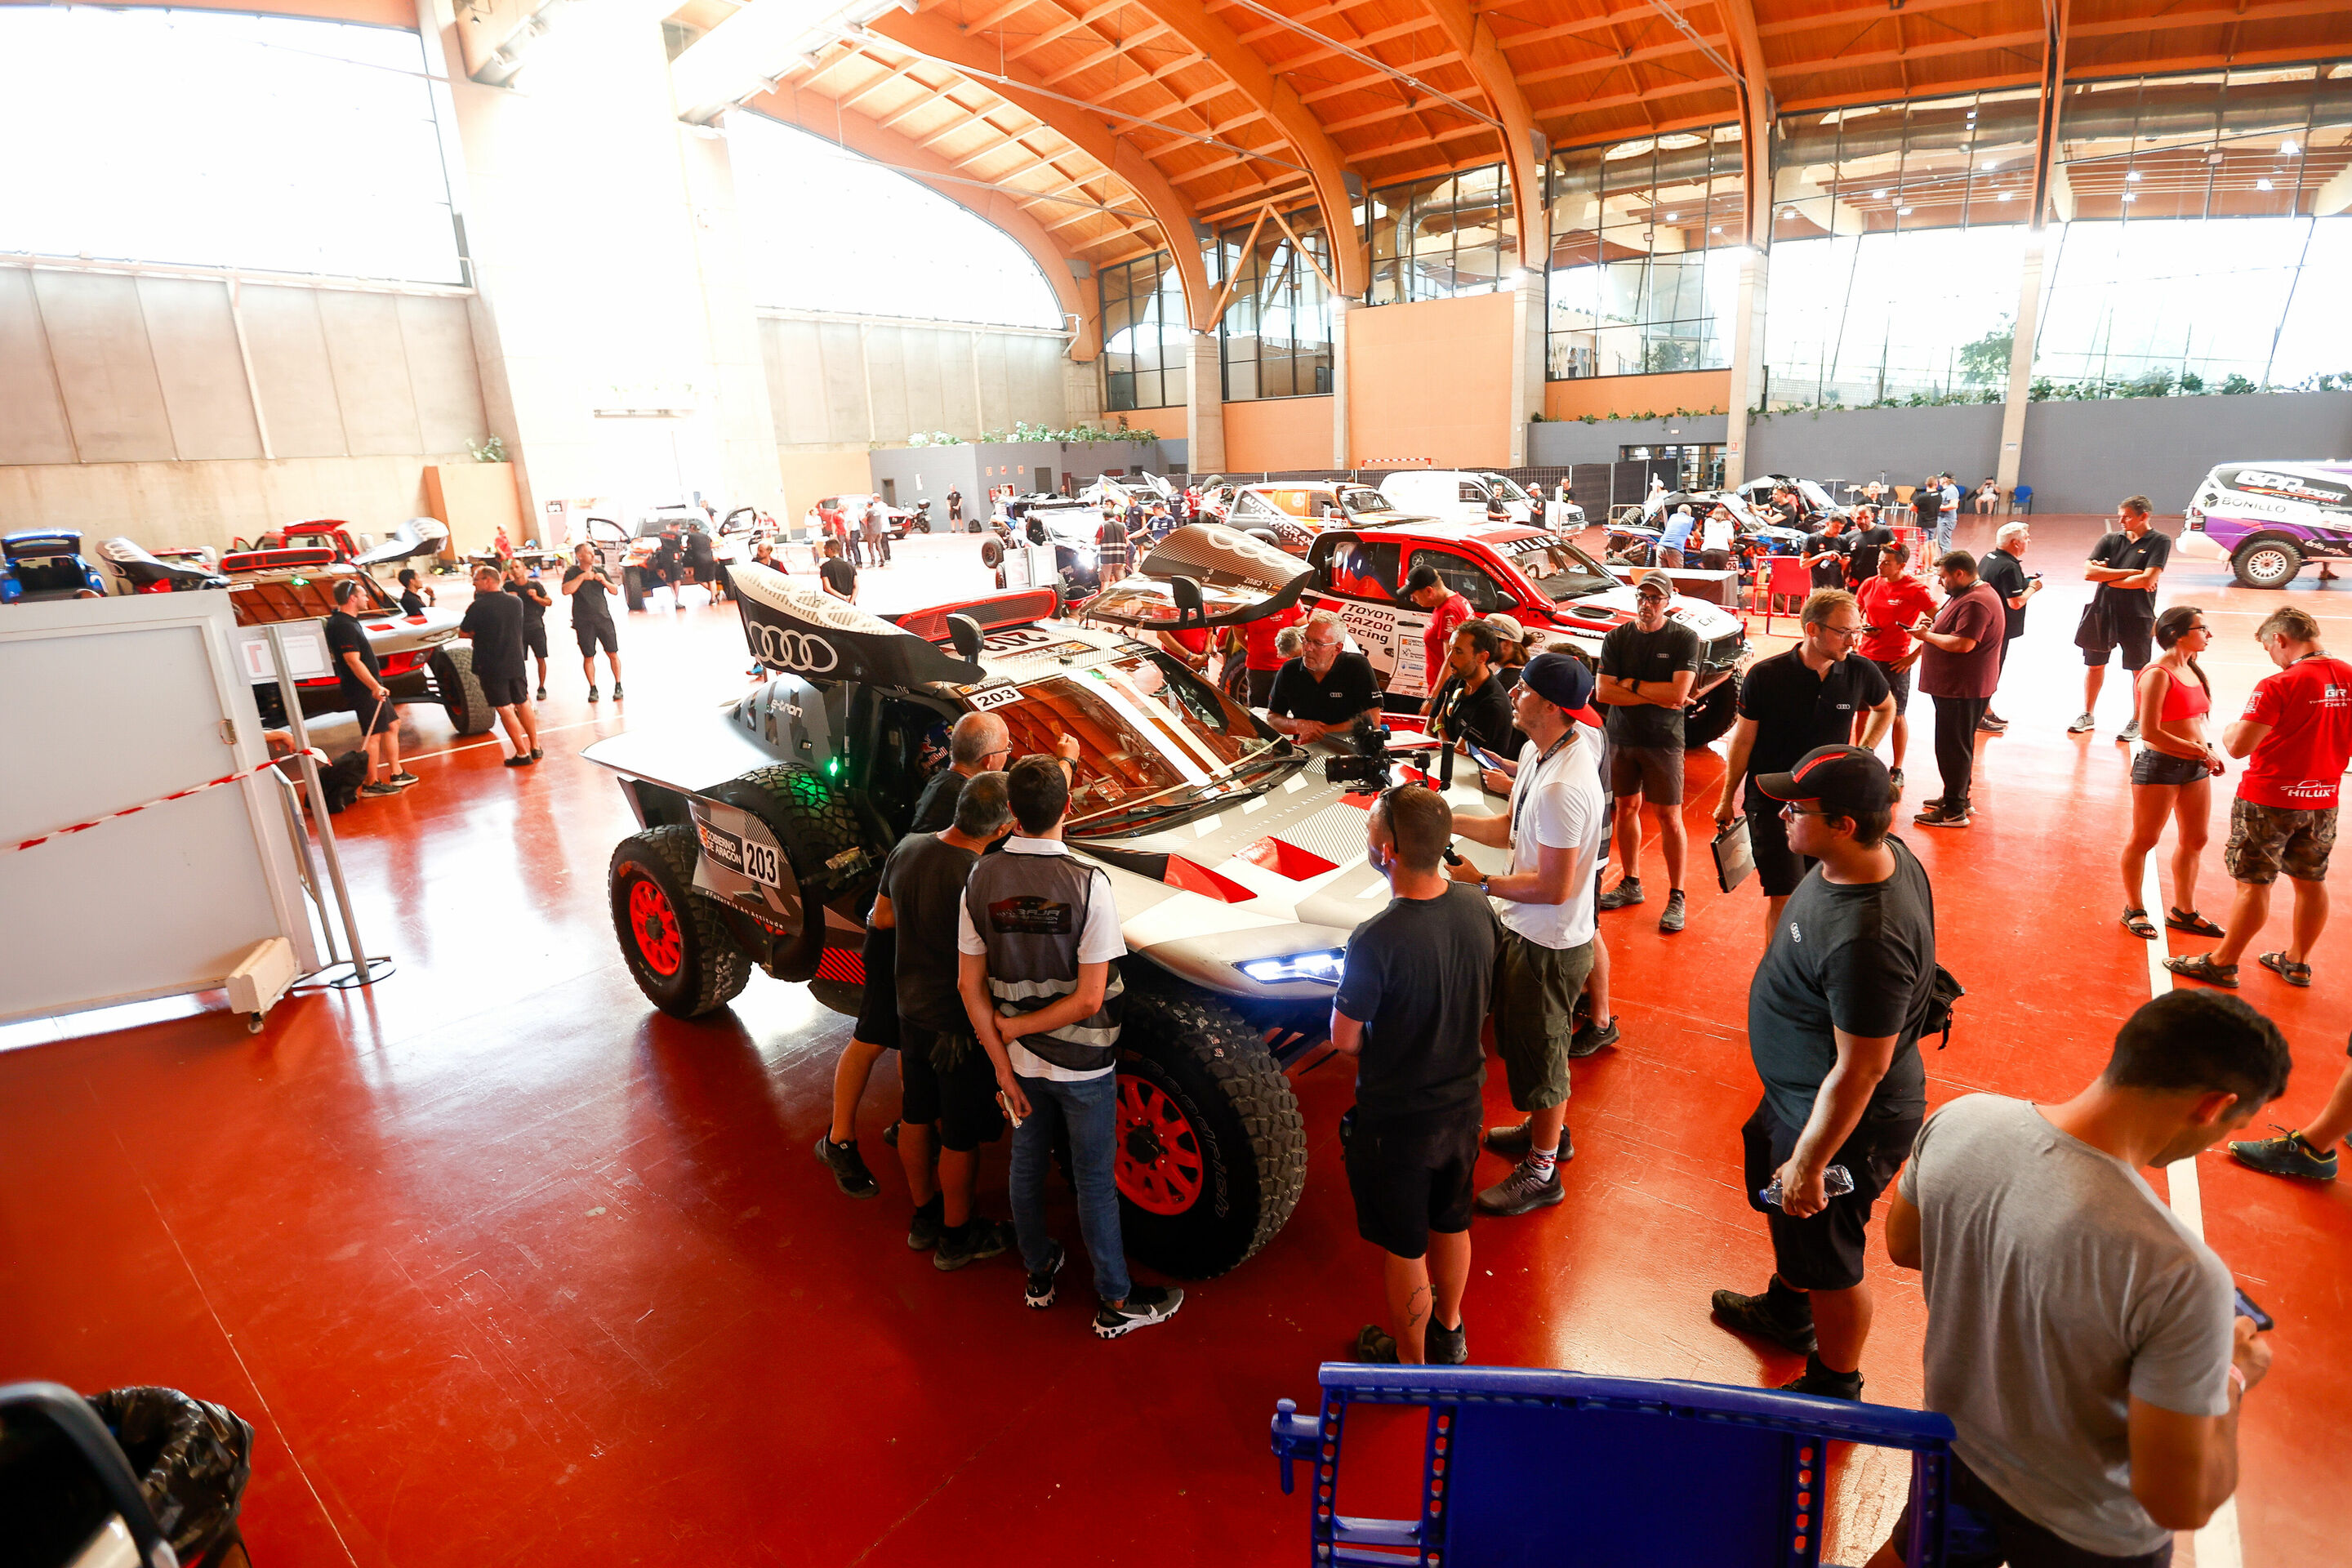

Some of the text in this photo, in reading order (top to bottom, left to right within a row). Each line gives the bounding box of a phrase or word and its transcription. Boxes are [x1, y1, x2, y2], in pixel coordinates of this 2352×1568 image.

[2221, 497, 2287, 514] BONILLO
[1243, 577, 1263, 586] CRUZ
[1341, 612, 1393, 632] GAZOO
[1346, 624, 1389, 645] acing
[977, 689, 1016, 707] 203
[2325, 688, 2347, 697] GR
[771, 699, 804, 718] e-tron
[2287, 789, 2332, 798] HILUX
[706, 830, 737, 852] GOBIERNO
[715, 844, 742, 866] ARAGON
[746, 843, 777, 884] 203
[751, 911, 784, 930] Attitude
